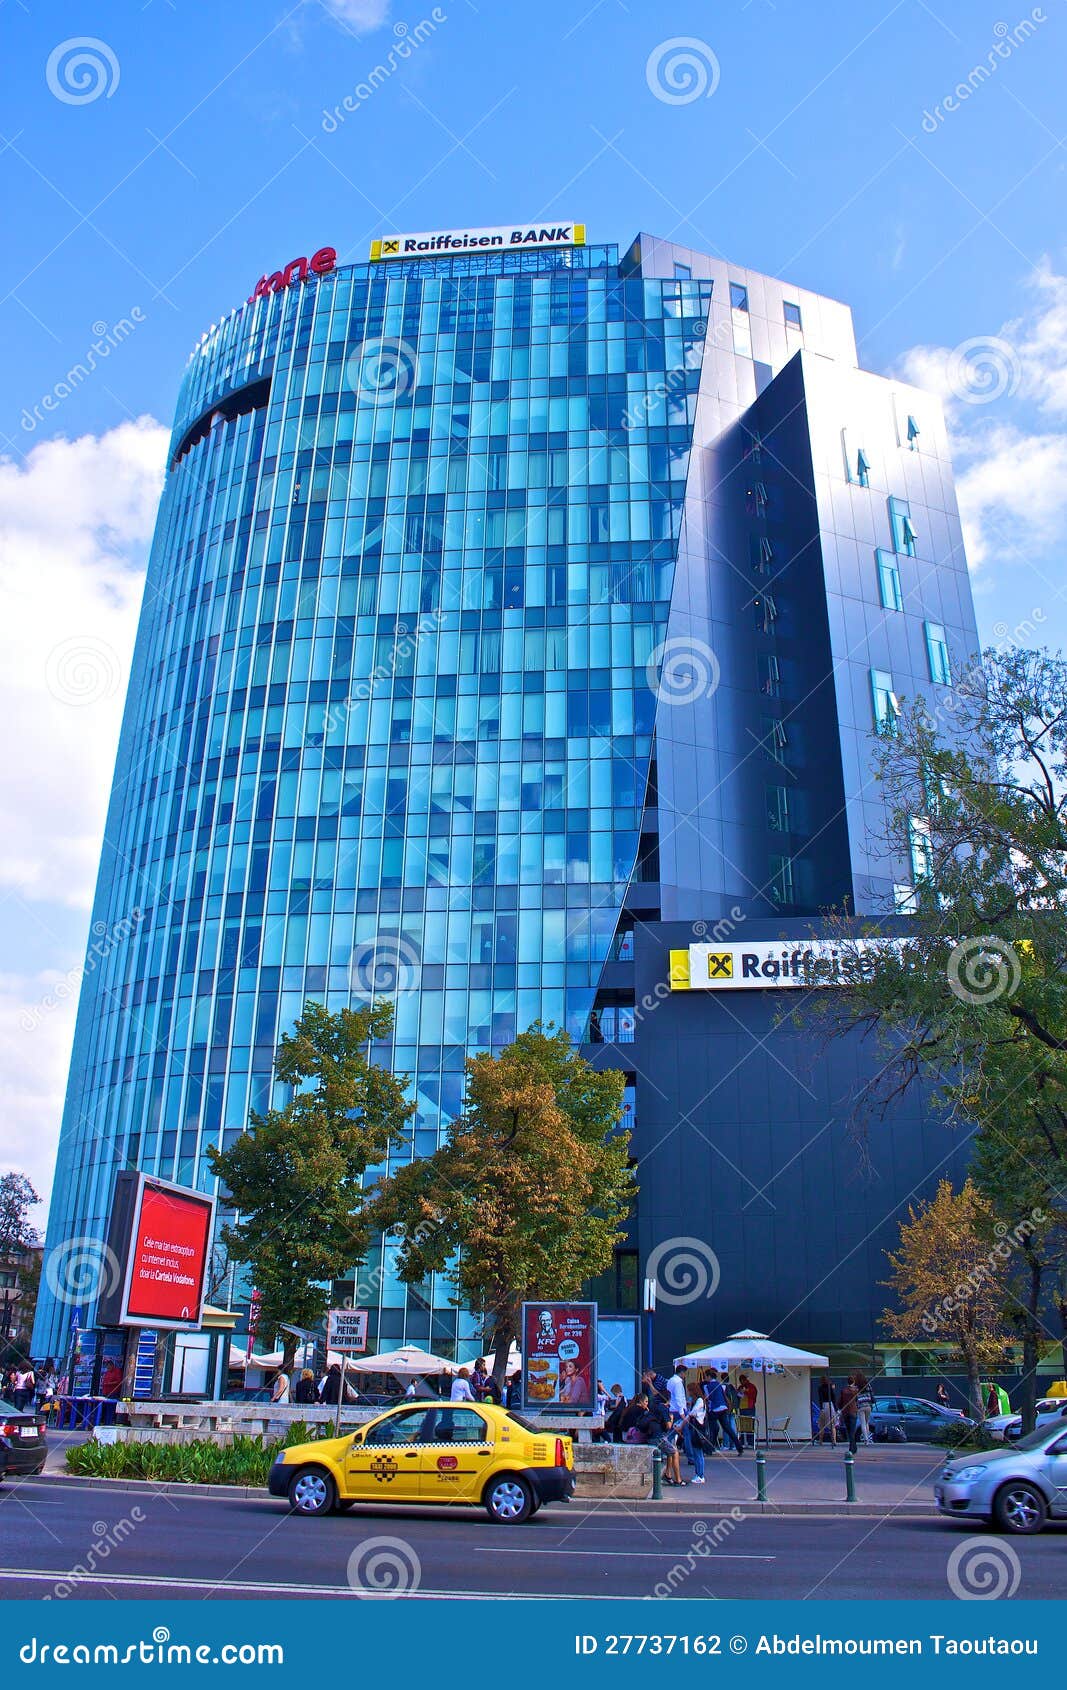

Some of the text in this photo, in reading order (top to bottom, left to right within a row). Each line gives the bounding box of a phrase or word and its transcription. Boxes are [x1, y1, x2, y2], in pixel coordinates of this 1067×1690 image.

[404, 227, 571, 252] Raiffeisen BANK
[741, 949, 888, 979] Raiffeise
[148, 1253, 166, 1266] internet
[155, 1269, 173, 1282] Cartela
[336, 1315, 361, 1325] TRECERE
[336, 1326, 358, 1335] PIETONI
